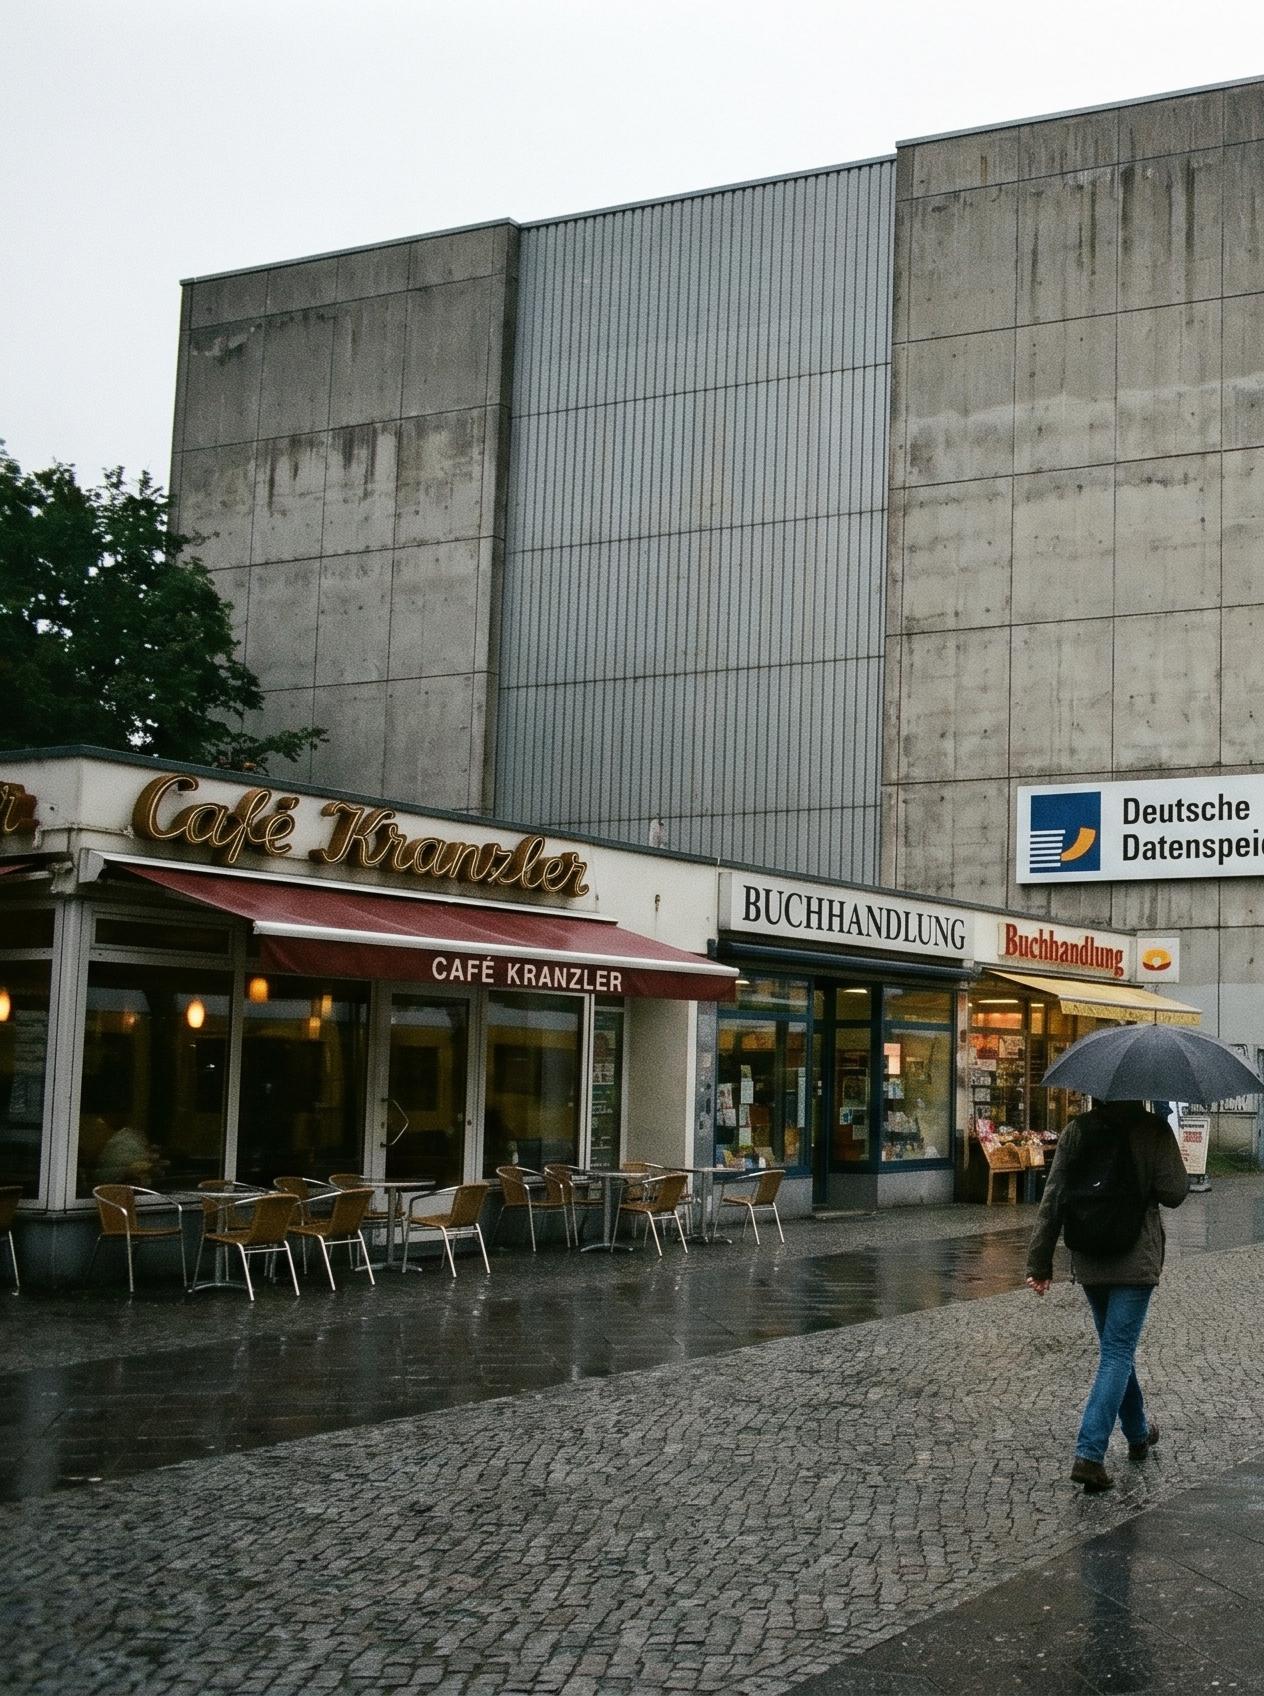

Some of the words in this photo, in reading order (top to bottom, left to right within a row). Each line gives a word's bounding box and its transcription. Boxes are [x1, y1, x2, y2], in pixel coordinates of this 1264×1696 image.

[132, 774, 300, 865] Café
[309, 801, 591, 898] Kranzler
[1123, 793, 1250, 825] Deutsche
[742, 885, 966, 950] BUCHHANDLUNG
[432, 956, 495, 983] CAFÉ
[507, 963, 622, 992] KRANZLER
[1005, 923, 1124, 977] Buchhandlung
